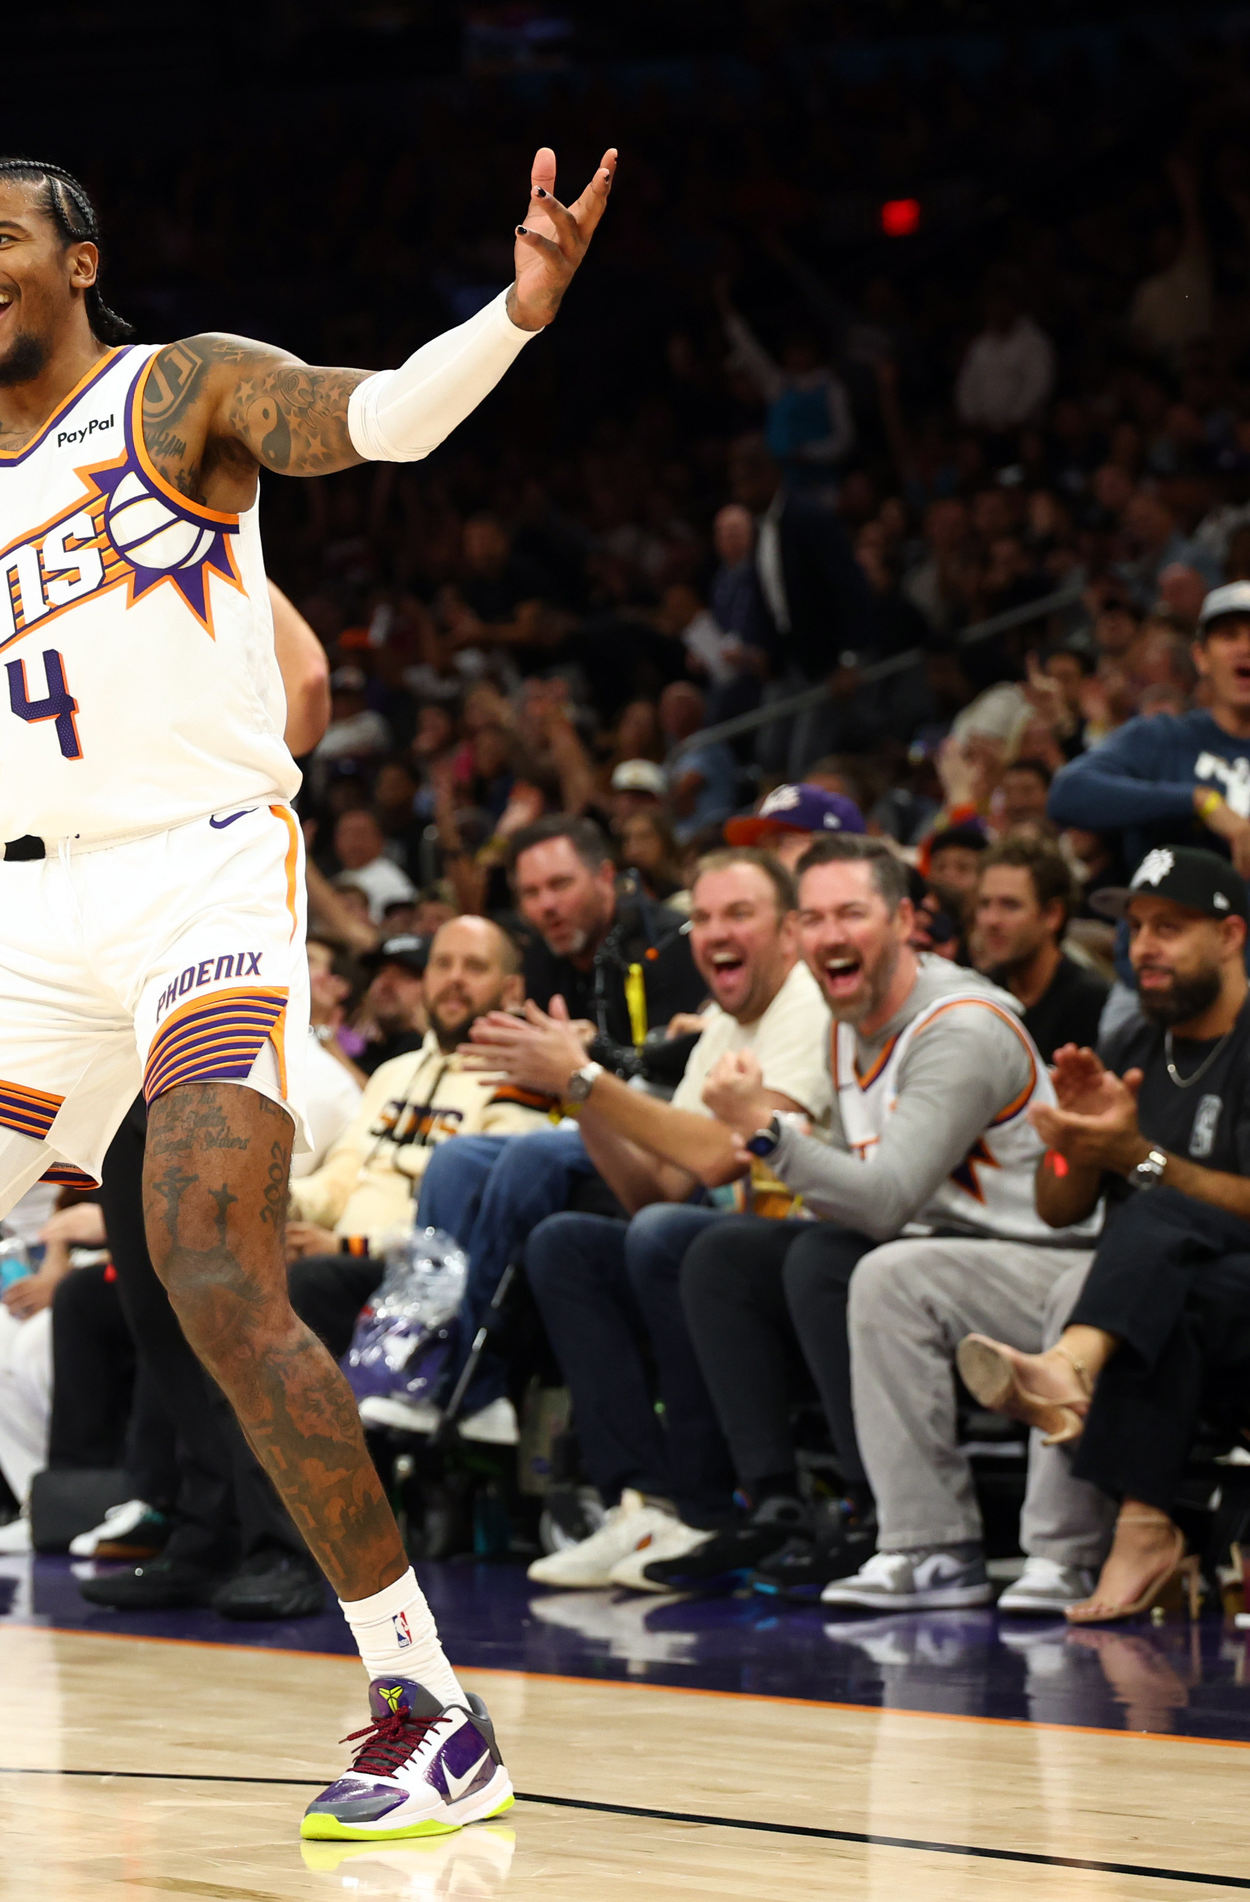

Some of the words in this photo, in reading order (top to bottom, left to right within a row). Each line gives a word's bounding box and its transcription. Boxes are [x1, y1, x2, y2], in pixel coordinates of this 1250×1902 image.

[57, 413, 114, 448] PayPal
[4, 648, 84, 761] 4
[156, 951, 263, 1024] PHOENIX
